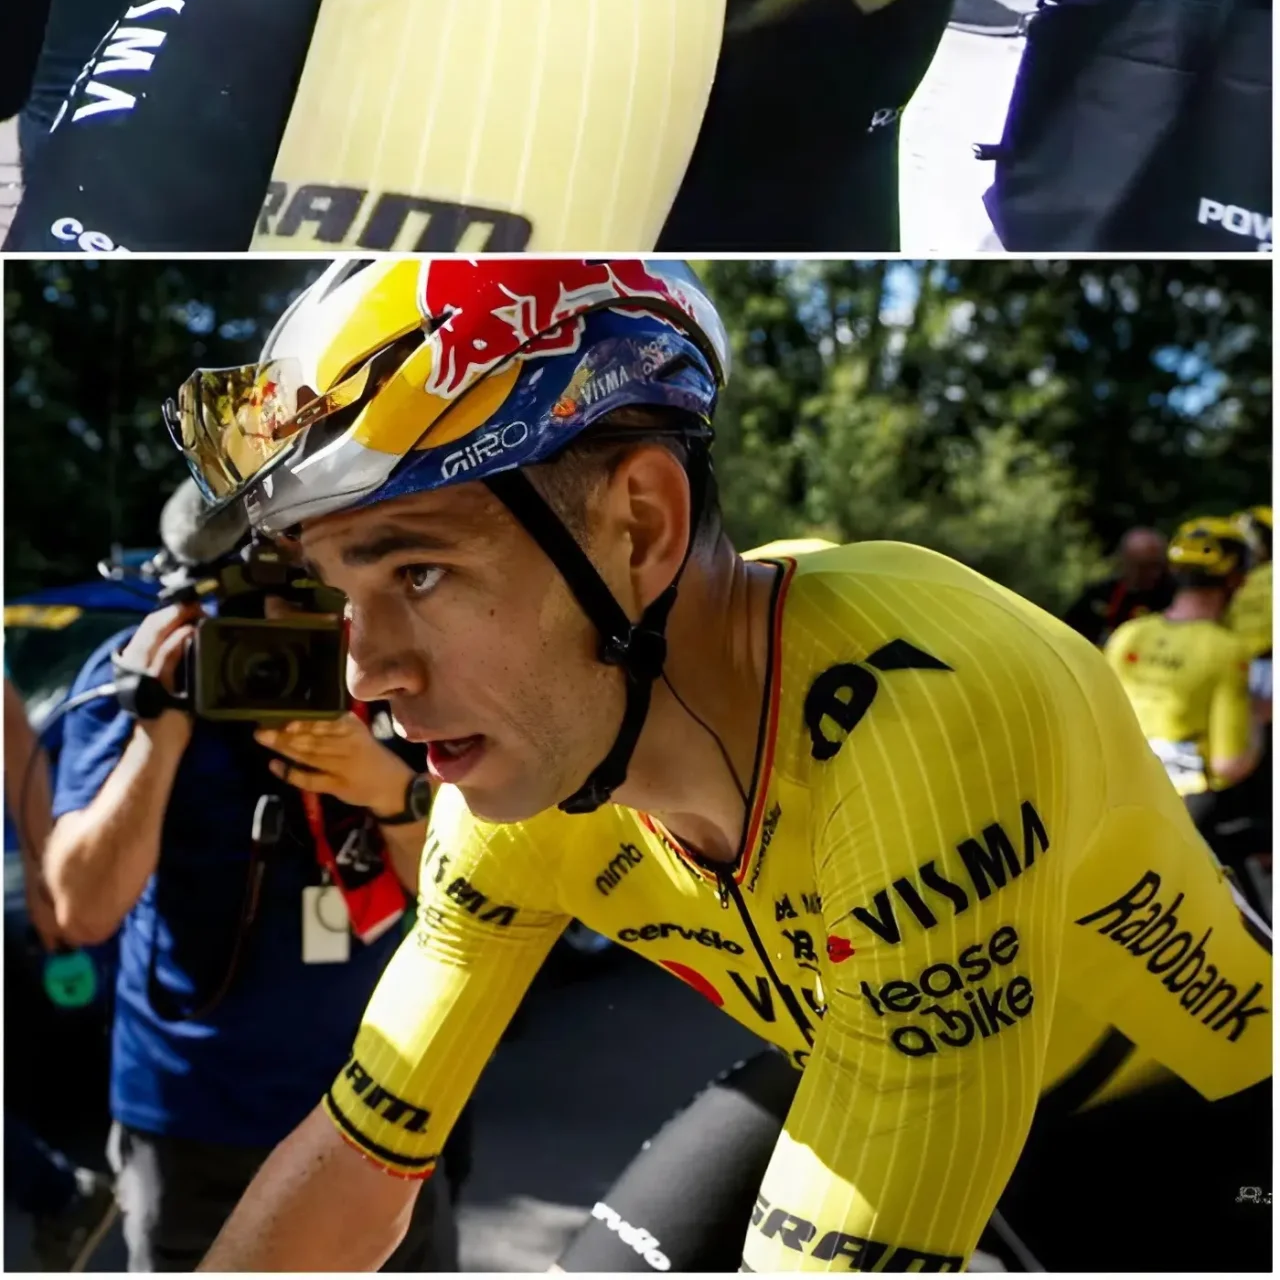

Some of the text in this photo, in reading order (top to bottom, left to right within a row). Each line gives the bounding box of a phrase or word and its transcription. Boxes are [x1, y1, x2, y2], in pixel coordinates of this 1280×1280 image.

[580, 365, 630, 405] VISMA
[441, 421, 528, 479] GIRO
[595, 841, 644, 897] nimb
[853, 800, 1050, 945] VISMA
[860, 925, 1020, 1018] lease
[1075, 869, 1269, 1043] Rabobank
